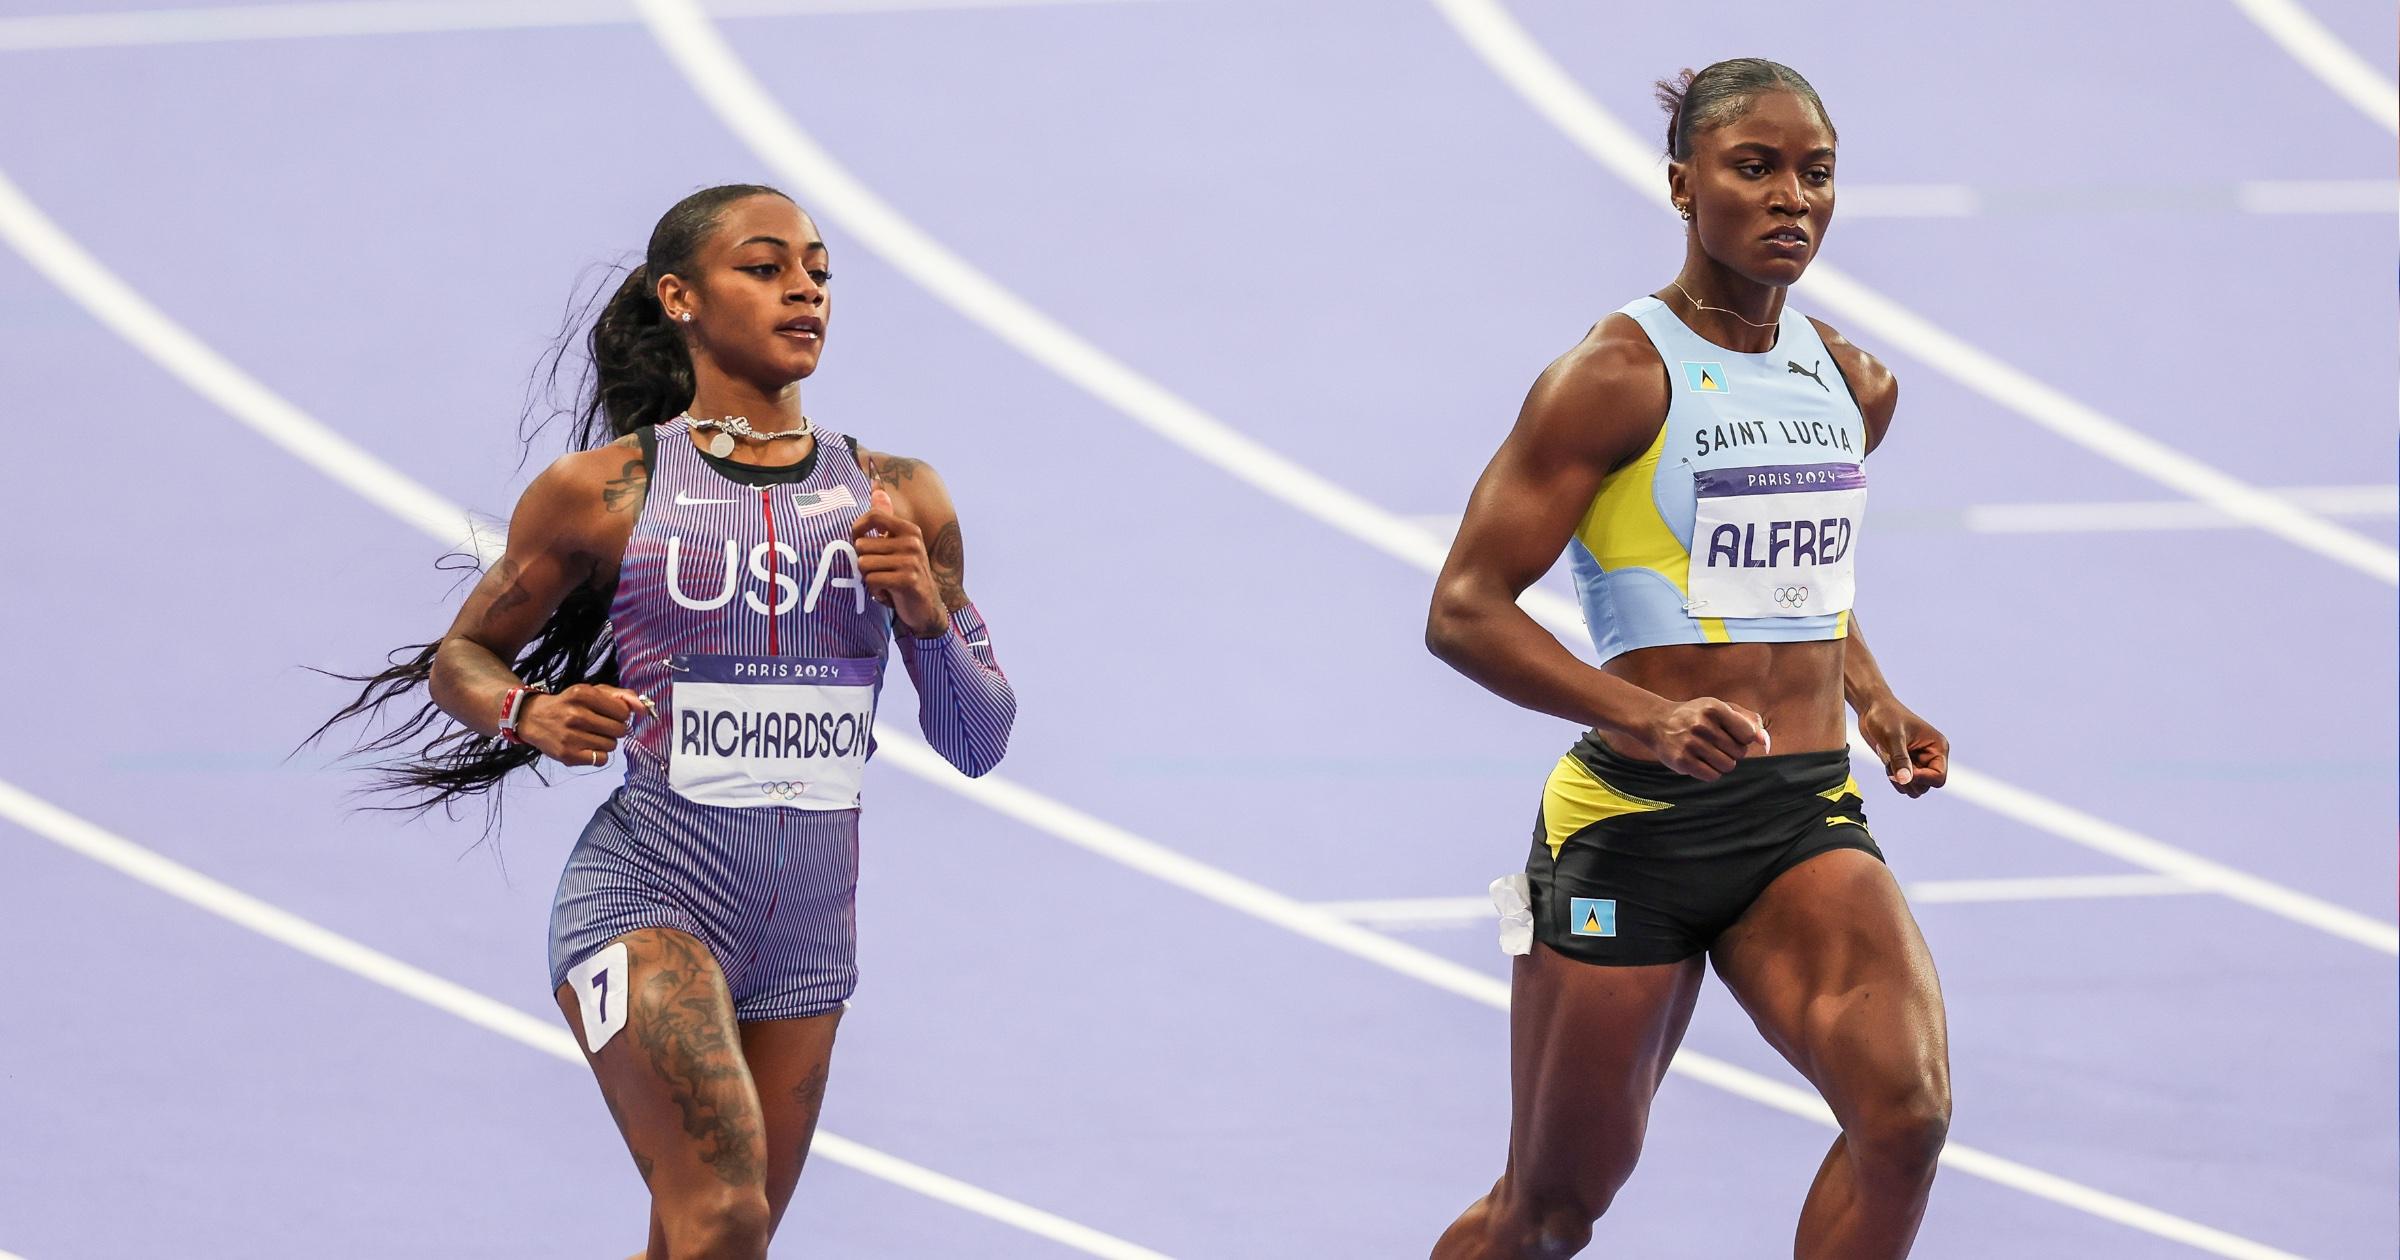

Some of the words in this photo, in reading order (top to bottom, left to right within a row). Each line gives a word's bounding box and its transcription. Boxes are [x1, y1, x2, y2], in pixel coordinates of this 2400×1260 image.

[1696, 420, 1768, 457] SAINT
[1779, 420, 1853, 454] LUCIA
[1796, 470, 1836, 485] 2024
[1707, 517, 1852, 568] ALFRED
[666, 535, 865, 616] USA
[794, 663, 839, 678] 2024
[681, 710, 870, 758] RICHARDSON
[591, 967, 609, 1025] 7
